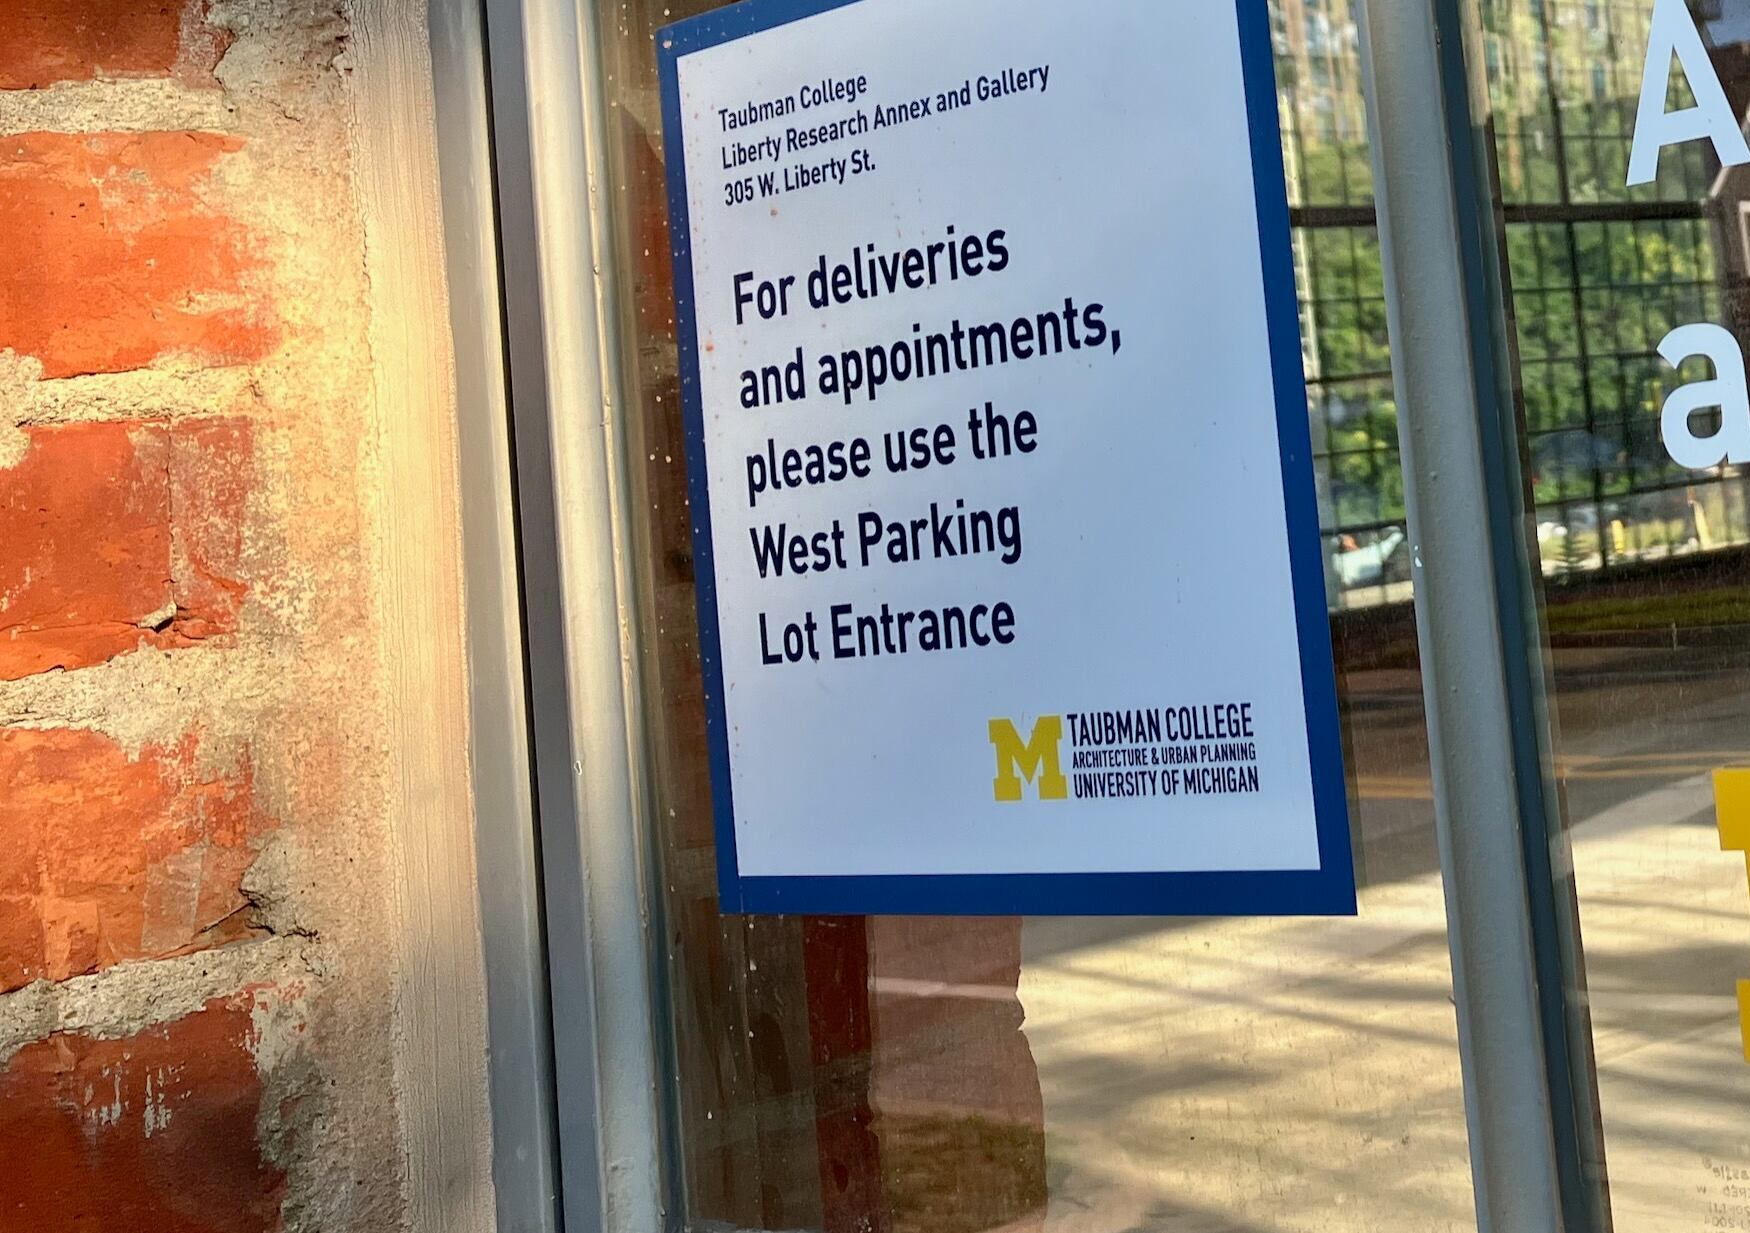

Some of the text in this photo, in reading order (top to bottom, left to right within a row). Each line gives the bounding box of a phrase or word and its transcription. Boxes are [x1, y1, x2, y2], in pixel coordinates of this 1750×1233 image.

[718, 75, 867, 132] Taubman College
[722, 65, 1049, 169] Liberty Research Annex and Gallery
[725, 148, 876, 206] 305 W. Liberty St.
[733, 224, 1009, 325] For deliveries
[740, 297, 1121, 409] and appointments,
[746, 402, 1037, 507] please use the
[750, 499, 1022, 579] West Parking
[759, 601, 1015, 665] Lot Entrance
[988, 715, 1068, 801] M
[1067, 702, 1254, 747] TAUBMAN COLLEGE
[1072, 743, 1256, 769] ARCHITECTURE & URBAN PLANNING
[1074, 765, 1259, 799] UNIVERSITY OF MICHIGAN
